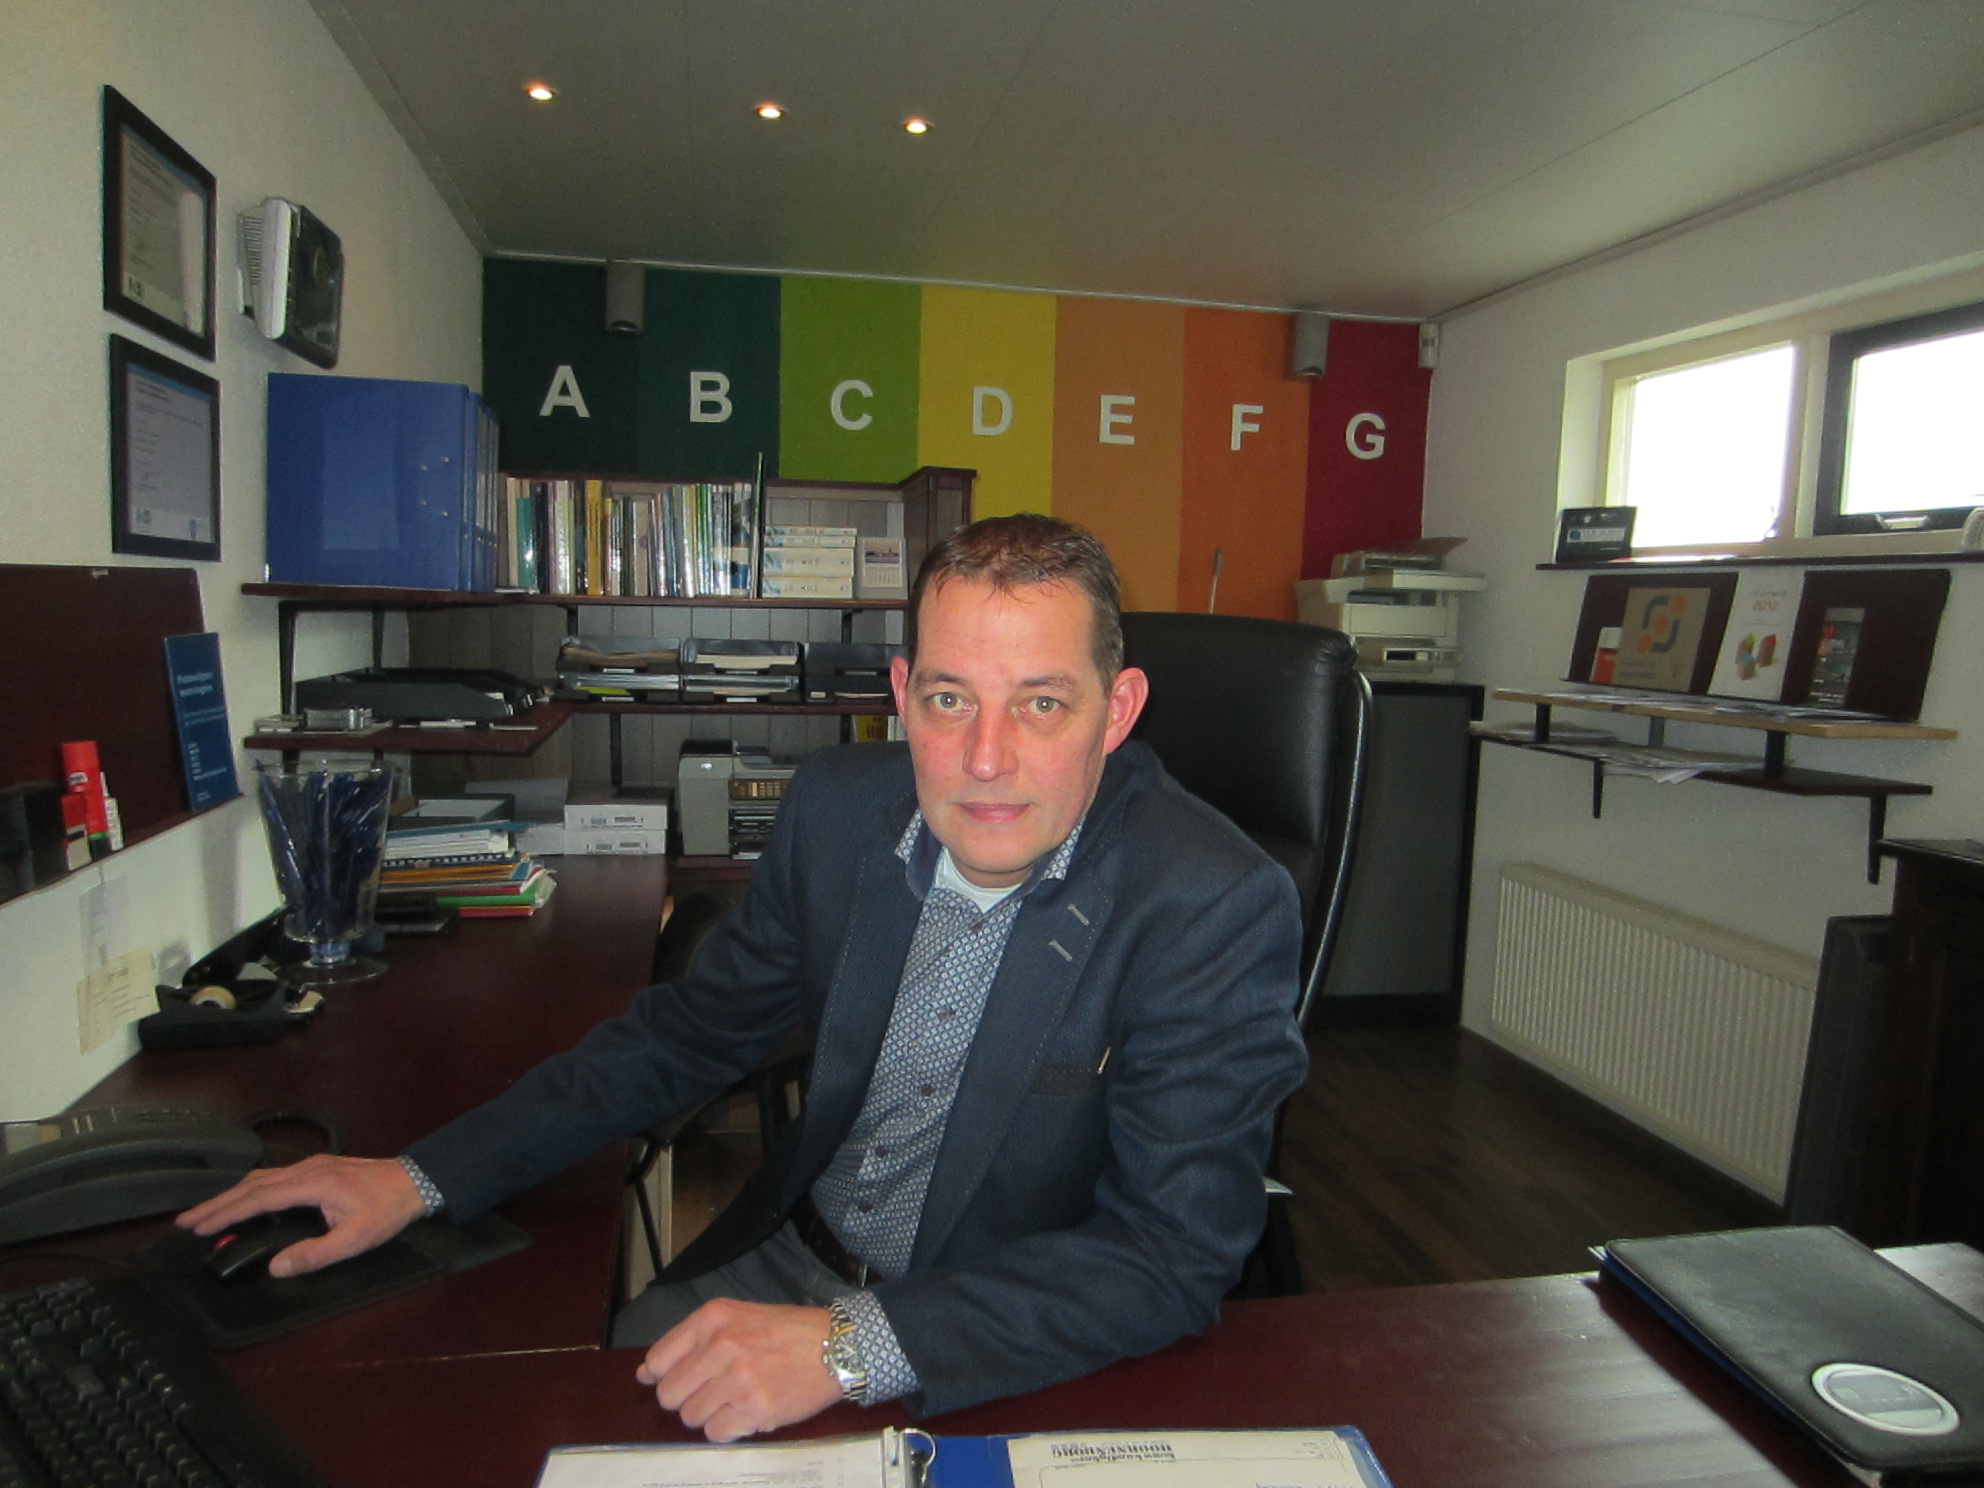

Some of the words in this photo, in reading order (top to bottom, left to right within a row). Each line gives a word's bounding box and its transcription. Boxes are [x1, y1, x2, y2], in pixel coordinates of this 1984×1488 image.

[540, 365, 590, 418] A
[689, 371, 733, 423] B
[830, 379, 874, 431] C
[972, 386, 1013, 437] D
[1099, 394, 1136, 445] E
[1231, 403, 1264, 452] F
[1345, 412, 1386, 460] G
